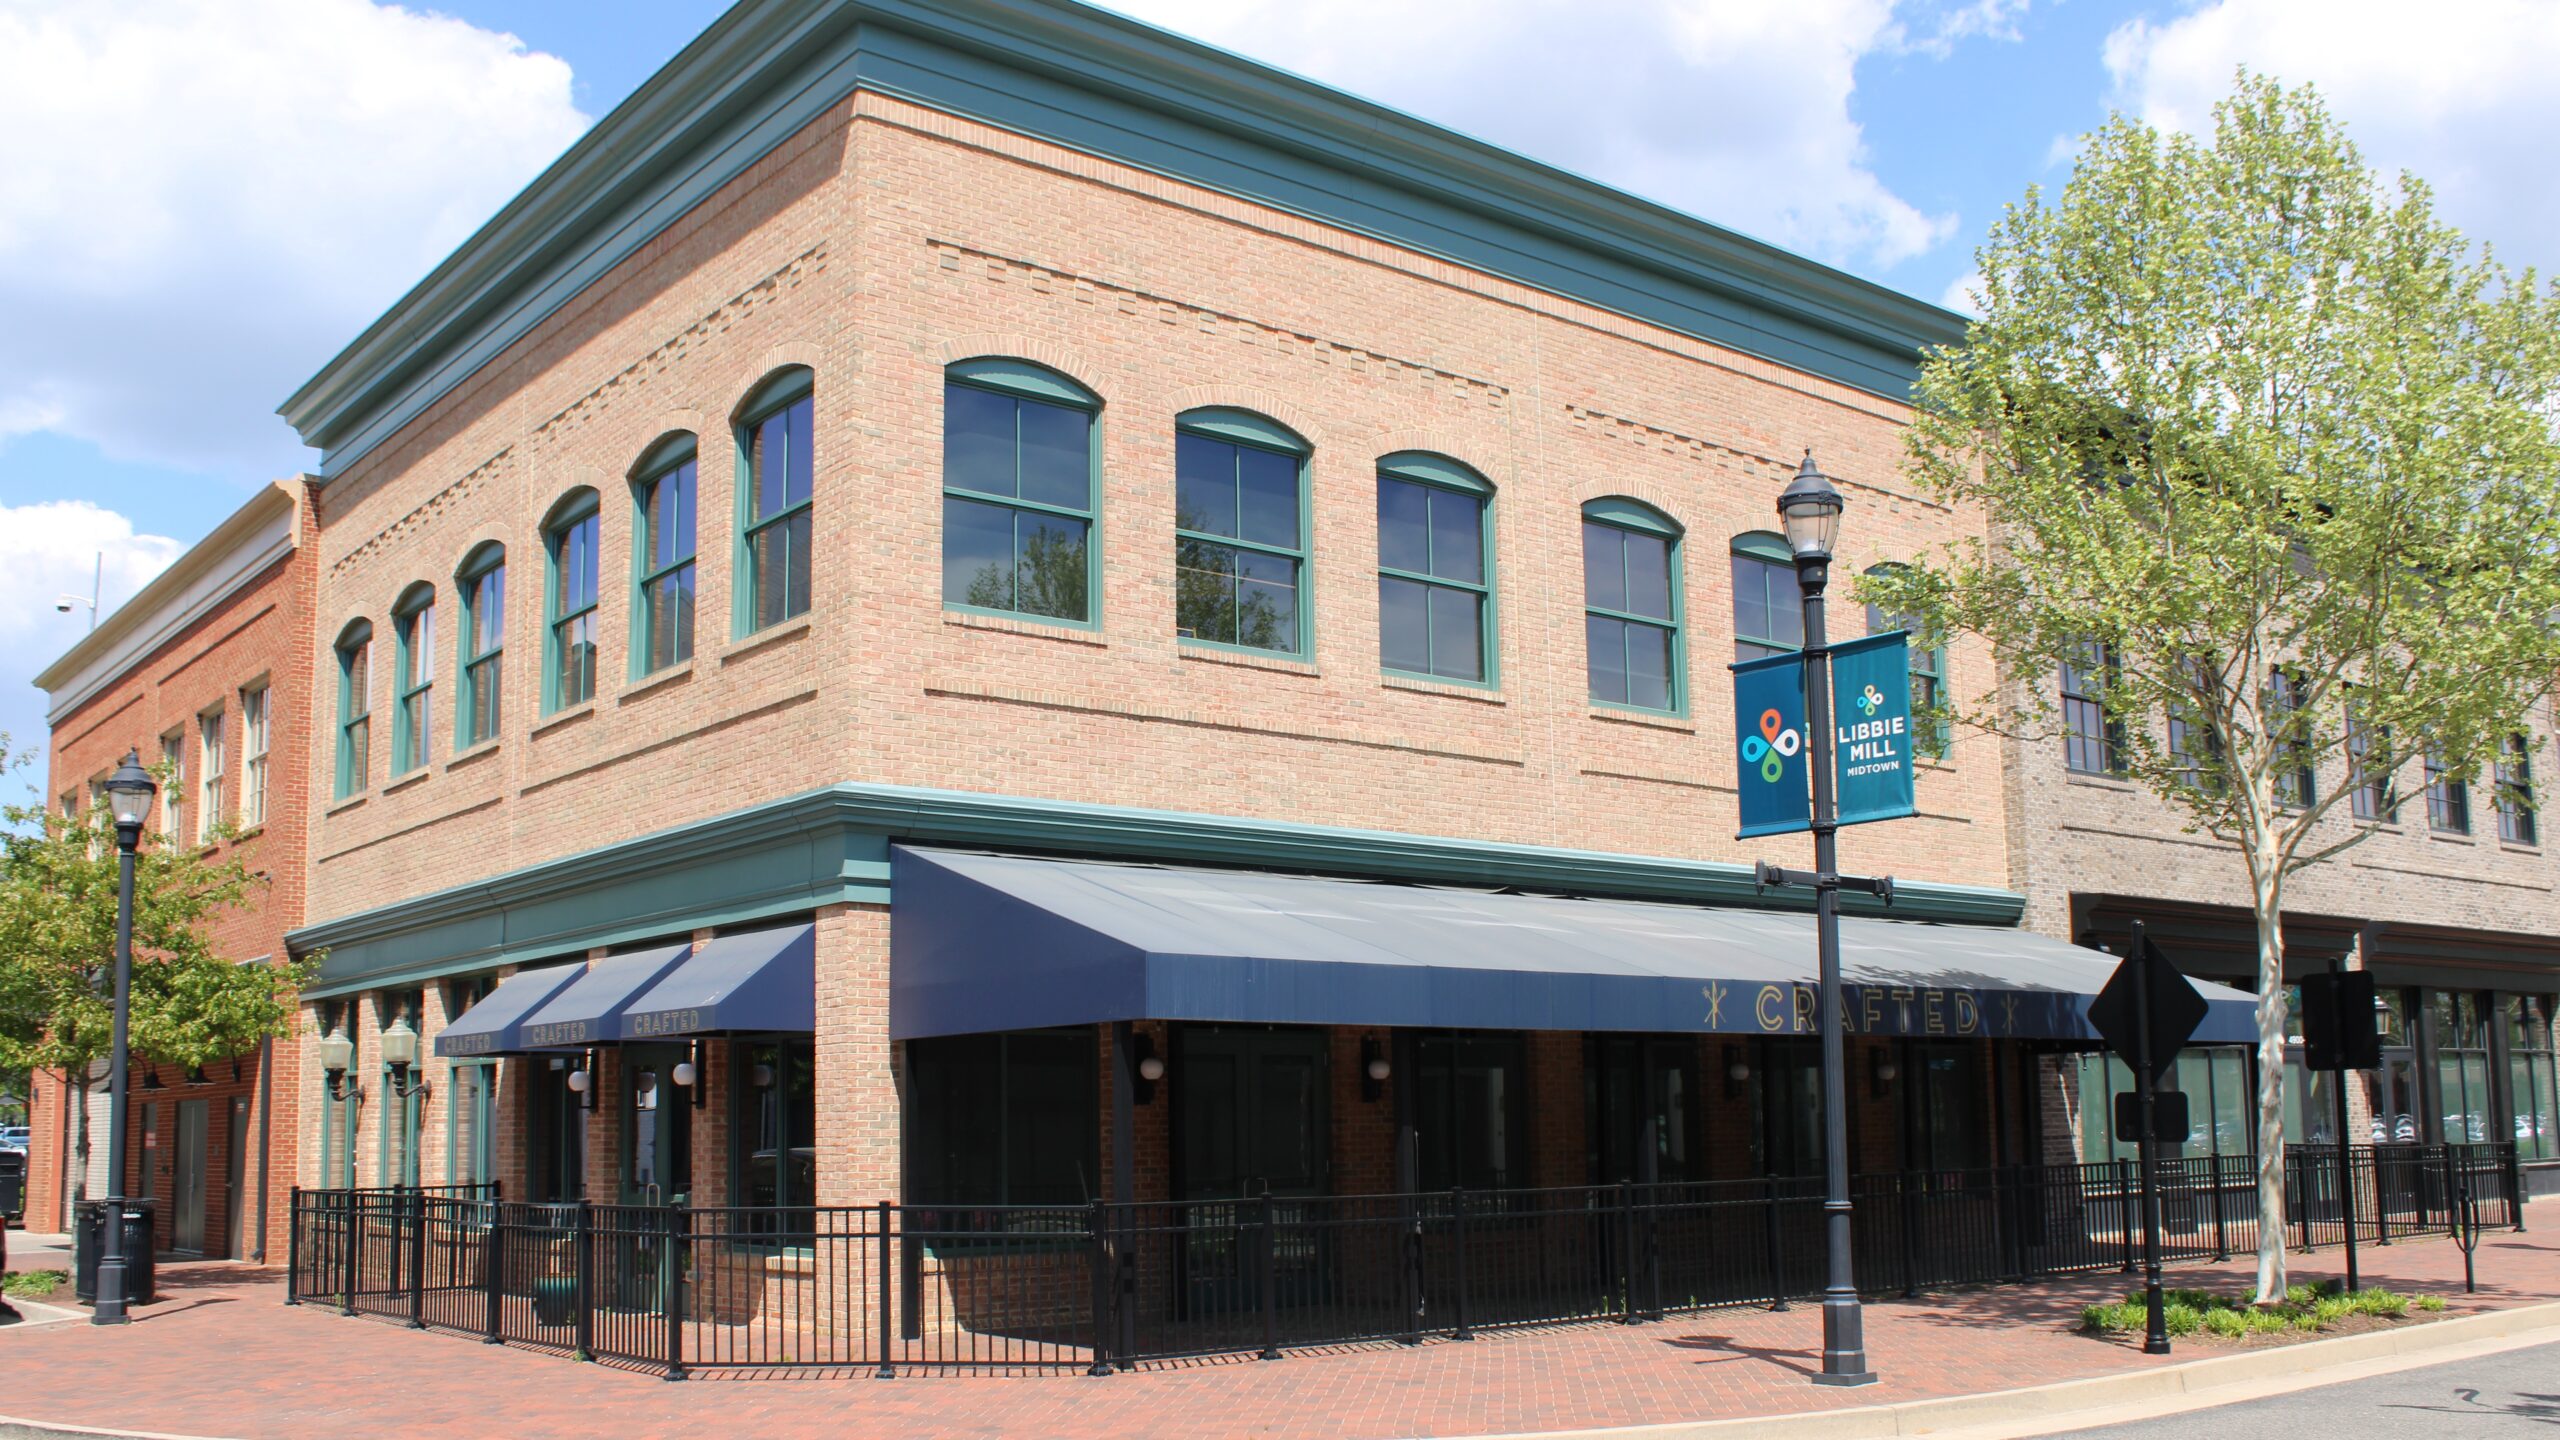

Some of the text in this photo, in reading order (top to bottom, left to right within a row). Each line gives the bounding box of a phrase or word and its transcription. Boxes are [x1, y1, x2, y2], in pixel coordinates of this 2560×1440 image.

[1838, 716, 1905, 743] LIBBIE
[1850, 739, 1896, 762] MILL
[1847, 760, 1900, 777] MIDTOWN
[532, 1021, 586, 1043] CRAFTED
[634, 1010, 699, 1034] CRAFTED
[445, 1033, 491, 1053] CRAFTED
